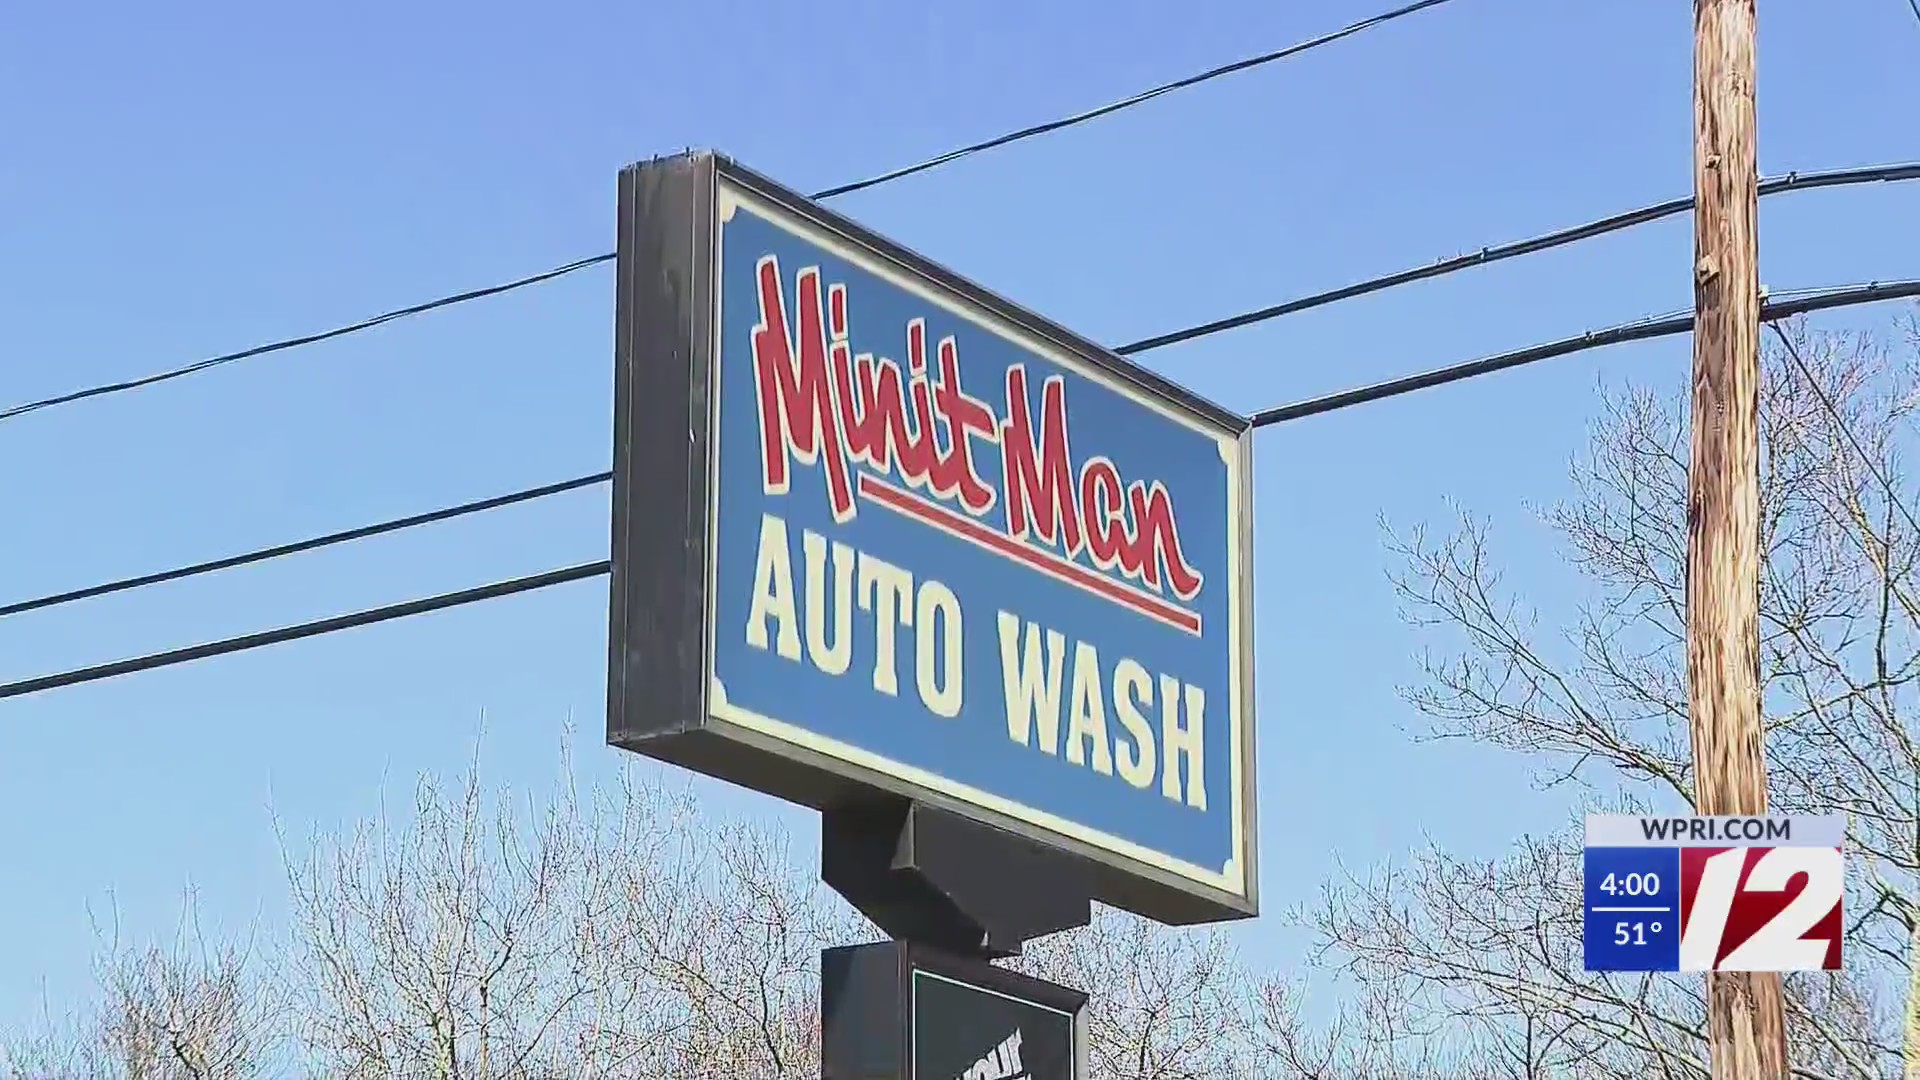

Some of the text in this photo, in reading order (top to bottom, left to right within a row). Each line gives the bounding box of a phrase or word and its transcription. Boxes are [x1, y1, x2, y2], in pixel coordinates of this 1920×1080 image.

[751, 254, 1204, 600] Minit Man
[746, 513, 1207, 811] AUTO WASH
